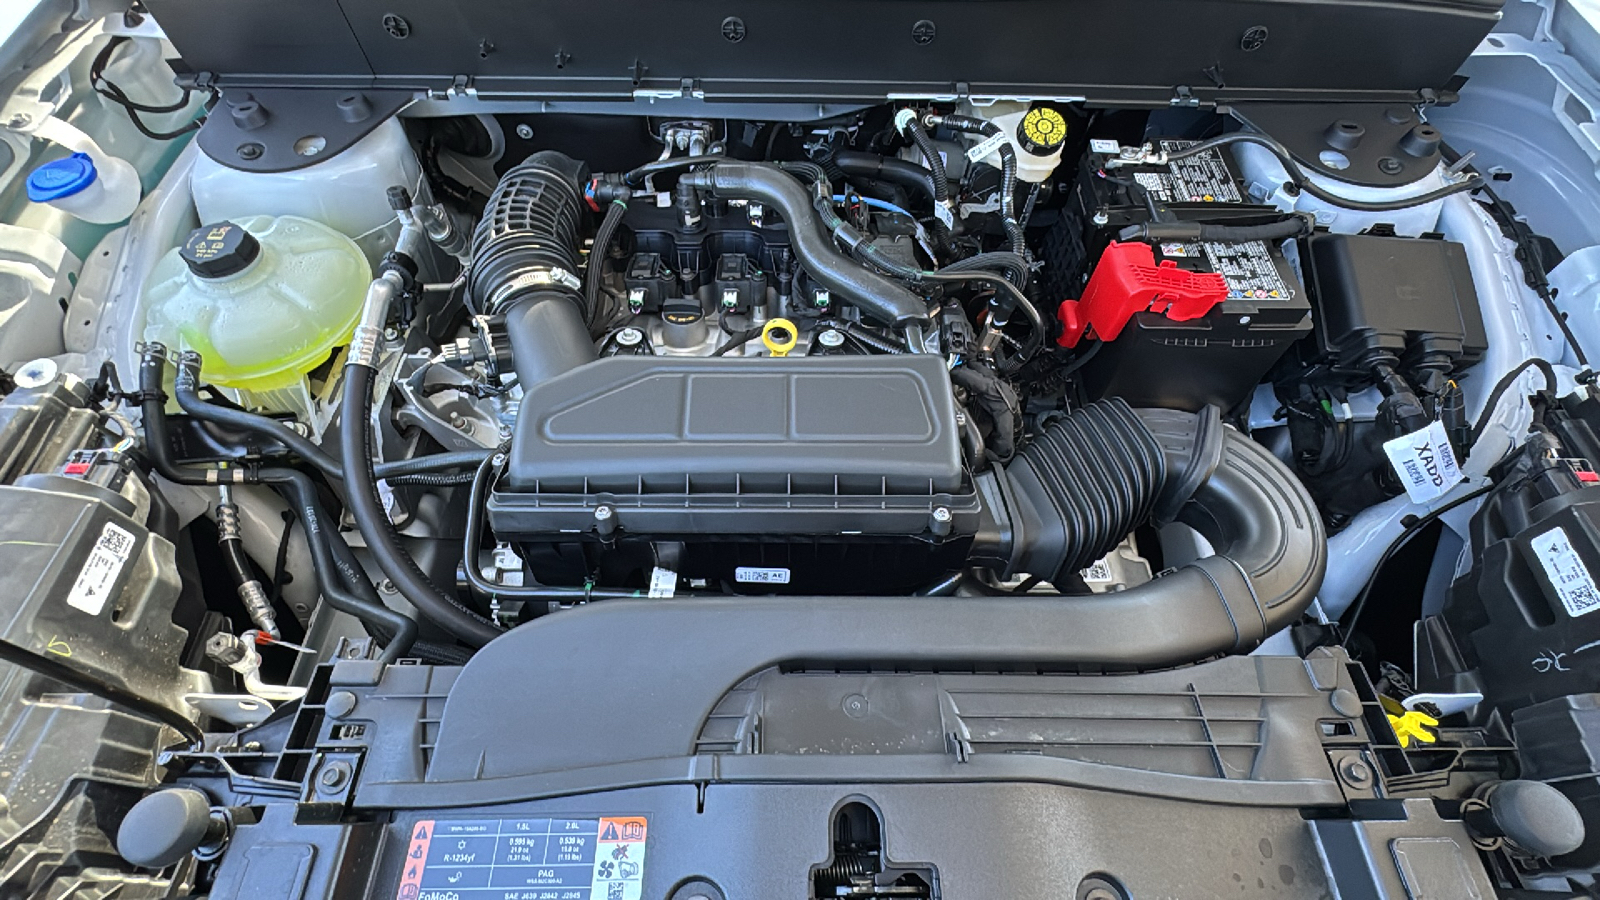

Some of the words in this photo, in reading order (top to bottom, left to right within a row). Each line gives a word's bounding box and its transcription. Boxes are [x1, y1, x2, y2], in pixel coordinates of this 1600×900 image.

[1413, 441, 1444, 487] XADD
[565, 821, 580, 830] 2.0L
[526, 838, 535, 847] kg
[576, 837, 585, 846] kg
[443, 853, 476, 863] R-1234yf
[538, 869, 554, 878] PAG
[418, 891, 459, 900] FoMoCo
[504, 892, 519, 900] SAE
